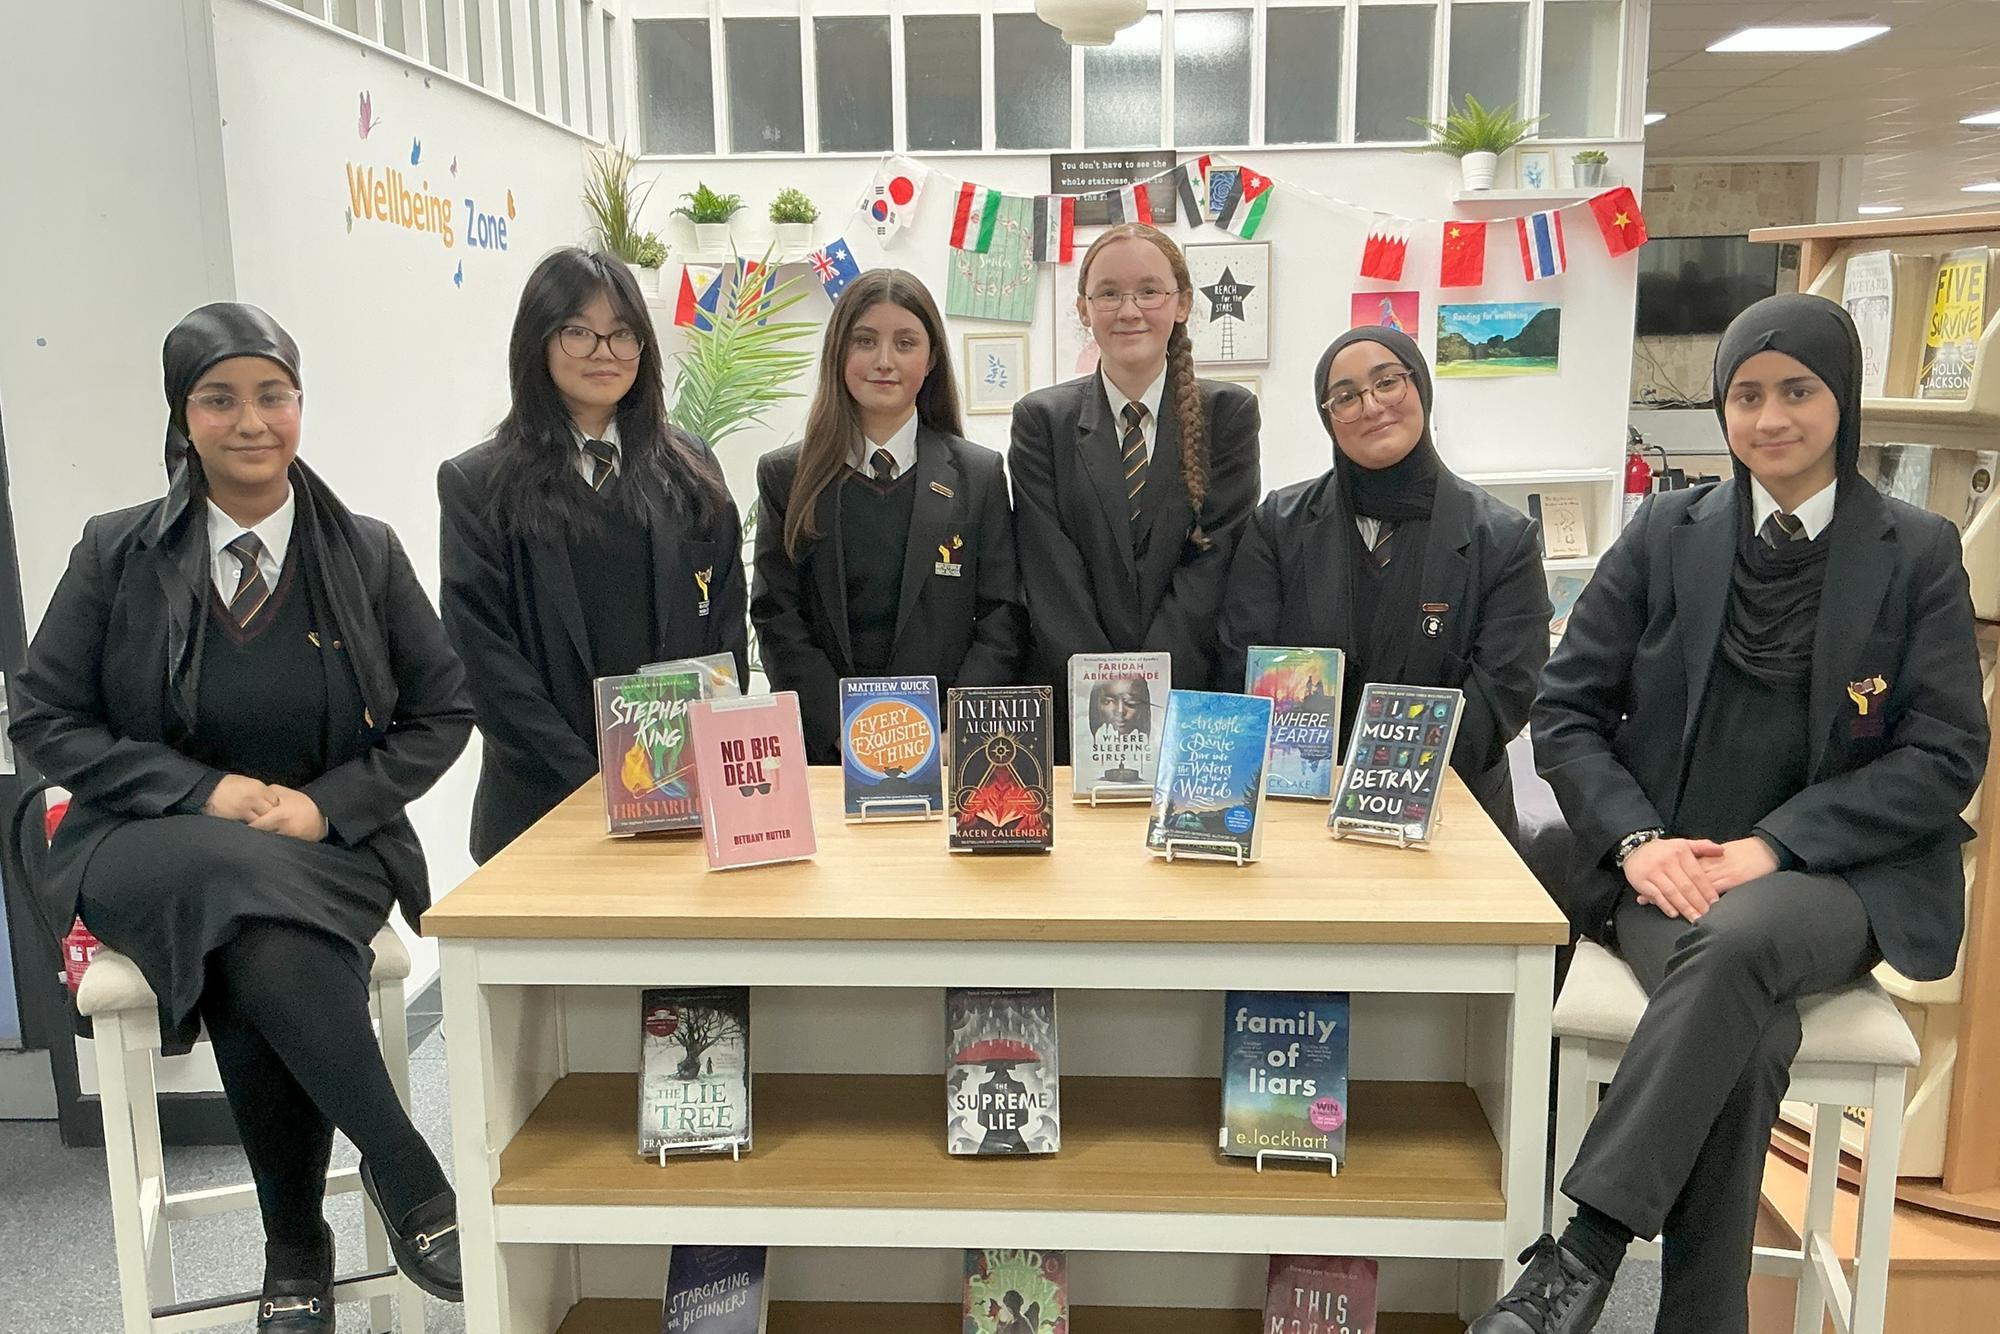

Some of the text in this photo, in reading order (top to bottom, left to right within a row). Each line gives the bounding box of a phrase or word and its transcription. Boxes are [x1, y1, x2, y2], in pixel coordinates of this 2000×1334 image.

[1061, 161, 1076, 170] You
[1079, 160, 1100, 170] don't
[1103, 160, 1122, 169] have
[1126, 160, 1134, 168] to
[1152, 160, 1167, 168] the
[1061, 177, 1086, 186] whole
[1088, 177, 1131, 186] staircase,
[346, 161, 508, 250] Wellbeing Zone
[1214, 284, 1237, 295] REACH
[1936, 266, 1982, 304] FIVE
[1215, 303, 1233, 313] STARS
[1221, 294, 1243, 302] for the
[1930, 306, 1979, 339] SURVIVE
[1932, 363, 1964, 375] HOLLY
[1925, 377, 1971, 389] JACKSON
[1098, 663, 1144, 671] FARIDAH
[848, 681, 930, 693] MATTHEW QUICK
[959, 698, 1043, 719] INFINITY
[1391, 700, 1400, 715] I
[856, 707, 911, 734] EVERY
[966, 719, 1037, 734] ALCHEMIST
[1181, 714, 1242, 737] Aristotle
[1273, 711, 1330, 728] WHERE
[633, 716, 682, 760] KING
[852, 720, 930, 755] EXQUISITE
[1102, 734, 1145, 743] WHERE
[1180, 732, 1235, 752] Dante
[1275, 728, 1330, 744] EARTH
[1362, 723, 1419, 741] MUST
[720, 736, 782, 764] NO BIG
[873, 740, 926, 766] THING
[1092, 744, 1151, 752] SLEEPING
[1092, 753, 1151, 762] GIRLS LIE
[724, 761, 767, 787] DEAL
[1191, 761, 1233, 779] Waters
[1173, 778, 1232, 800] World
[1350, 768, 1430, 793] BETRAY
[1358, 794, 1403, 815] YOU
[734, 829, 792, 846] BETHANY RUTTER
[956, 828, 1048, 838] KACEN CALLENDER
[1235, 1007, 1337, 1044] family
[1267, 1043, 1300, 1068] of
[1249, 1068, 1317, 1097] liars
[656, 1082, 727, 1105] THE LIE
[957, 1093, 1049, 1111] SUPREME
[1316, 1102, 1339, 1111] WIN
[654, 1103, 734, 1135] TREE
[988, 1113, 1016, 1131] LIE
[1236, 1128, 1329, 1149] e.lockhart
[984, 1249, 1043, 1273] READ
[669, 1272, 750, 1314] STARGAZING
[668, 1290, 748, 1332] FOR BEGINNERS
[1294, 1287, 1348, 1325] THIS
